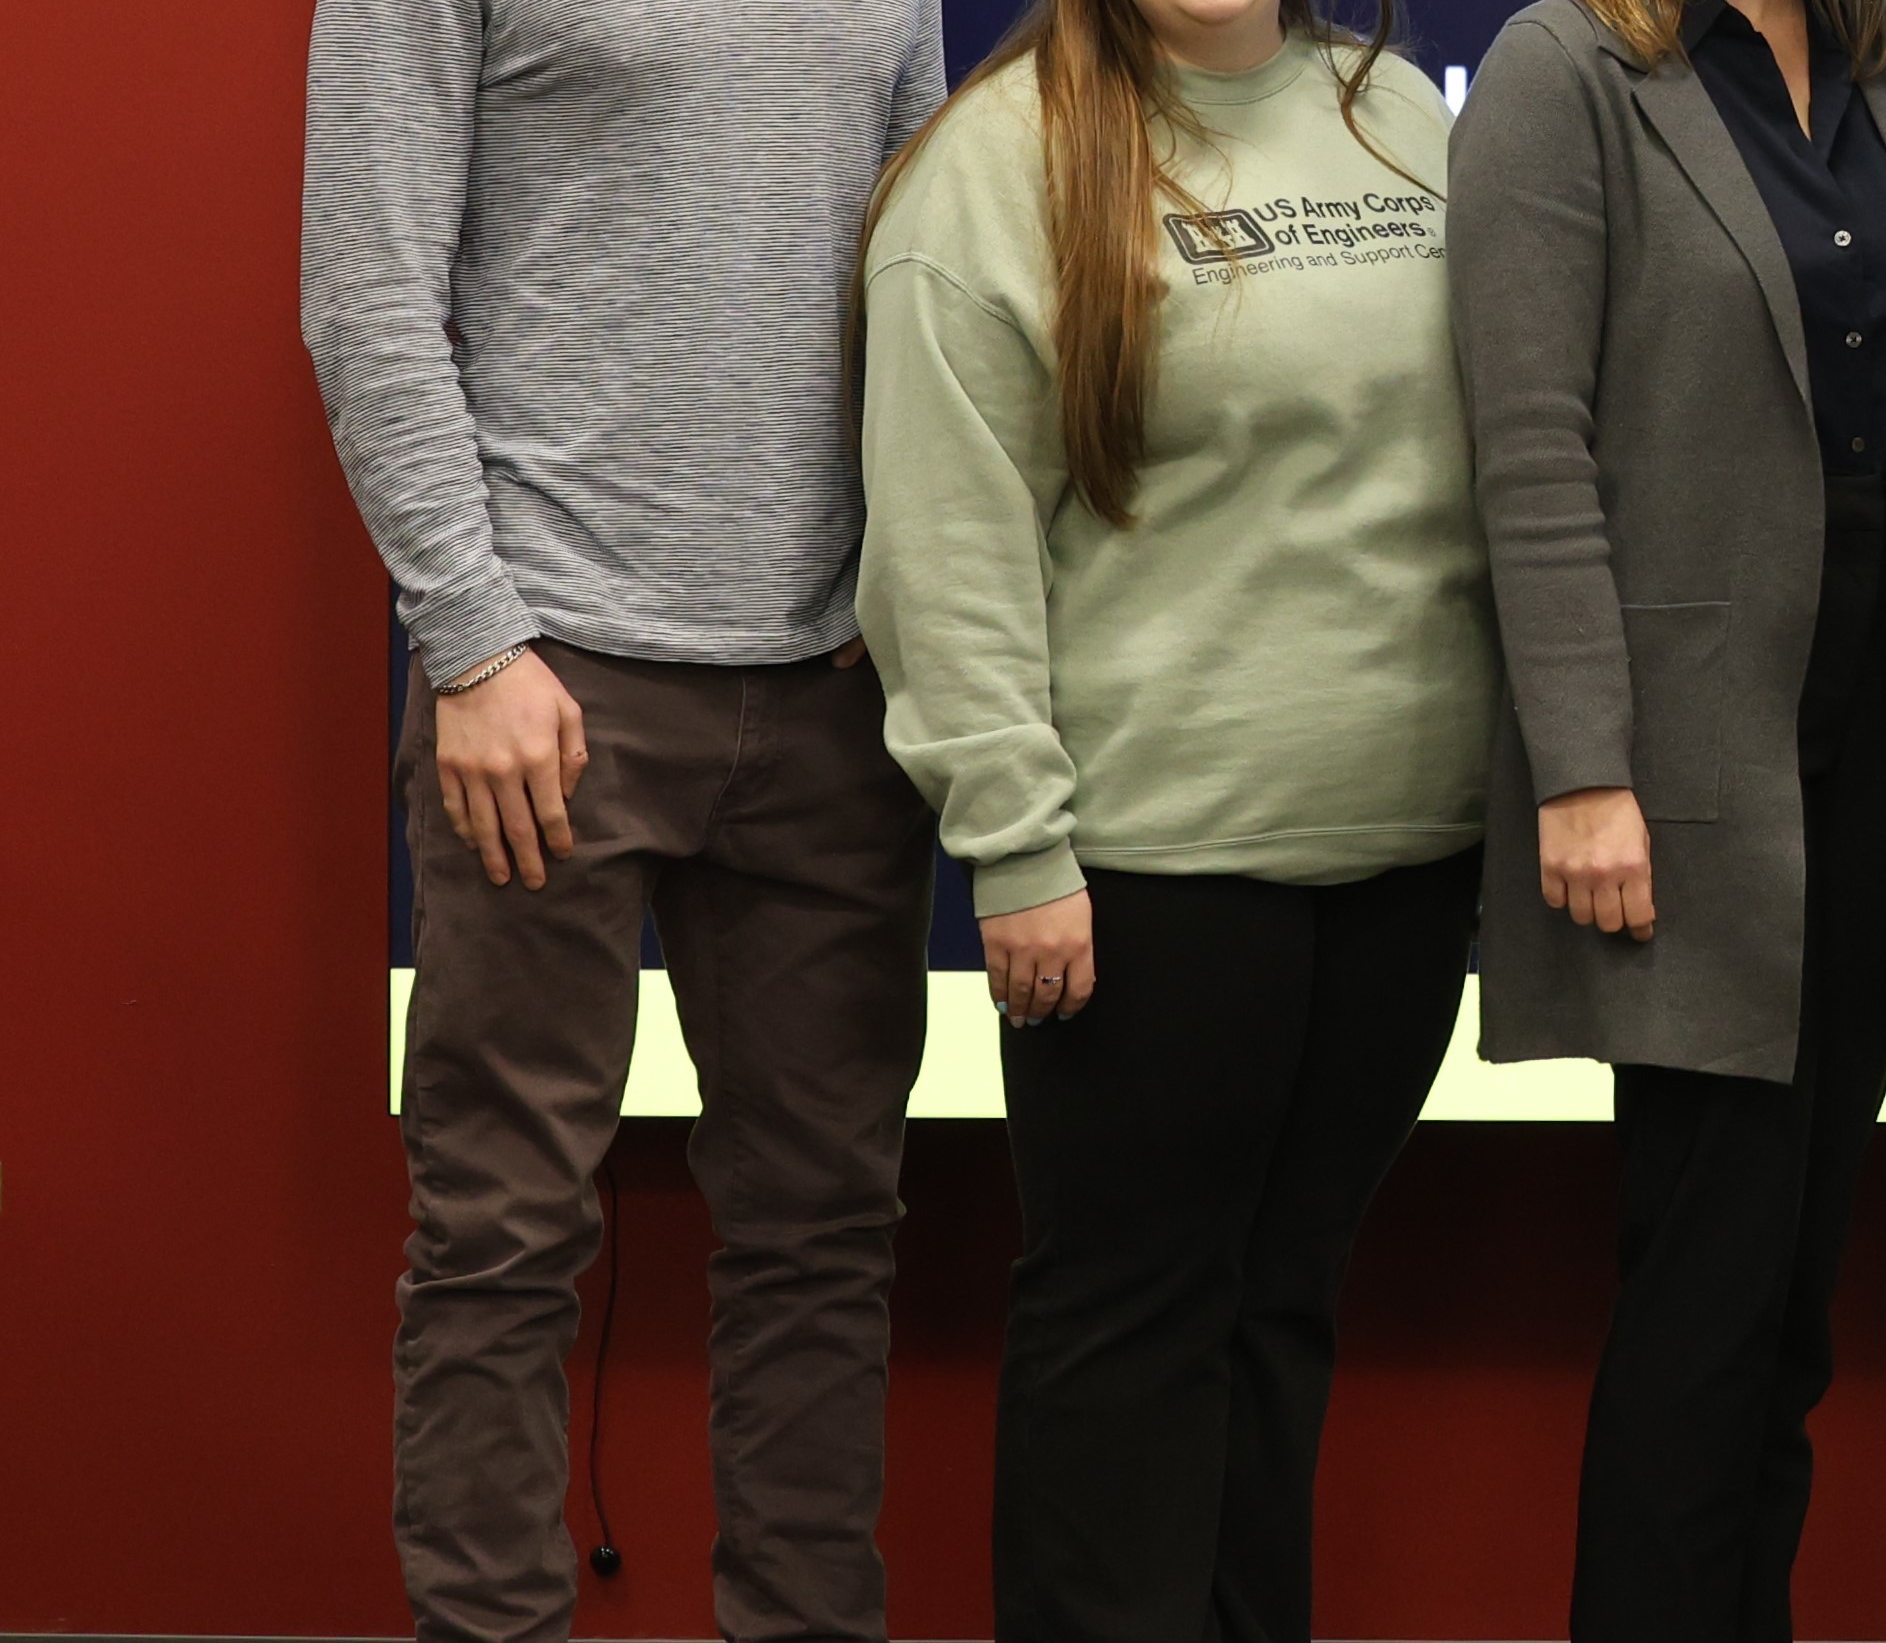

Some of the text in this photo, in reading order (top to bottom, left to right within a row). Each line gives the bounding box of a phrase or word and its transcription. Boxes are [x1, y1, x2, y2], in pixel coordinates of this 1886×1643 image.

[1252, 193, 1435, 223] US Army Corps
[1275, 224, 1300, 246] of
[1192, 256, 1304, 285] Engineering
[1307, 251, 1338, 268] and
[1343, 244, 1415, 266] Support
